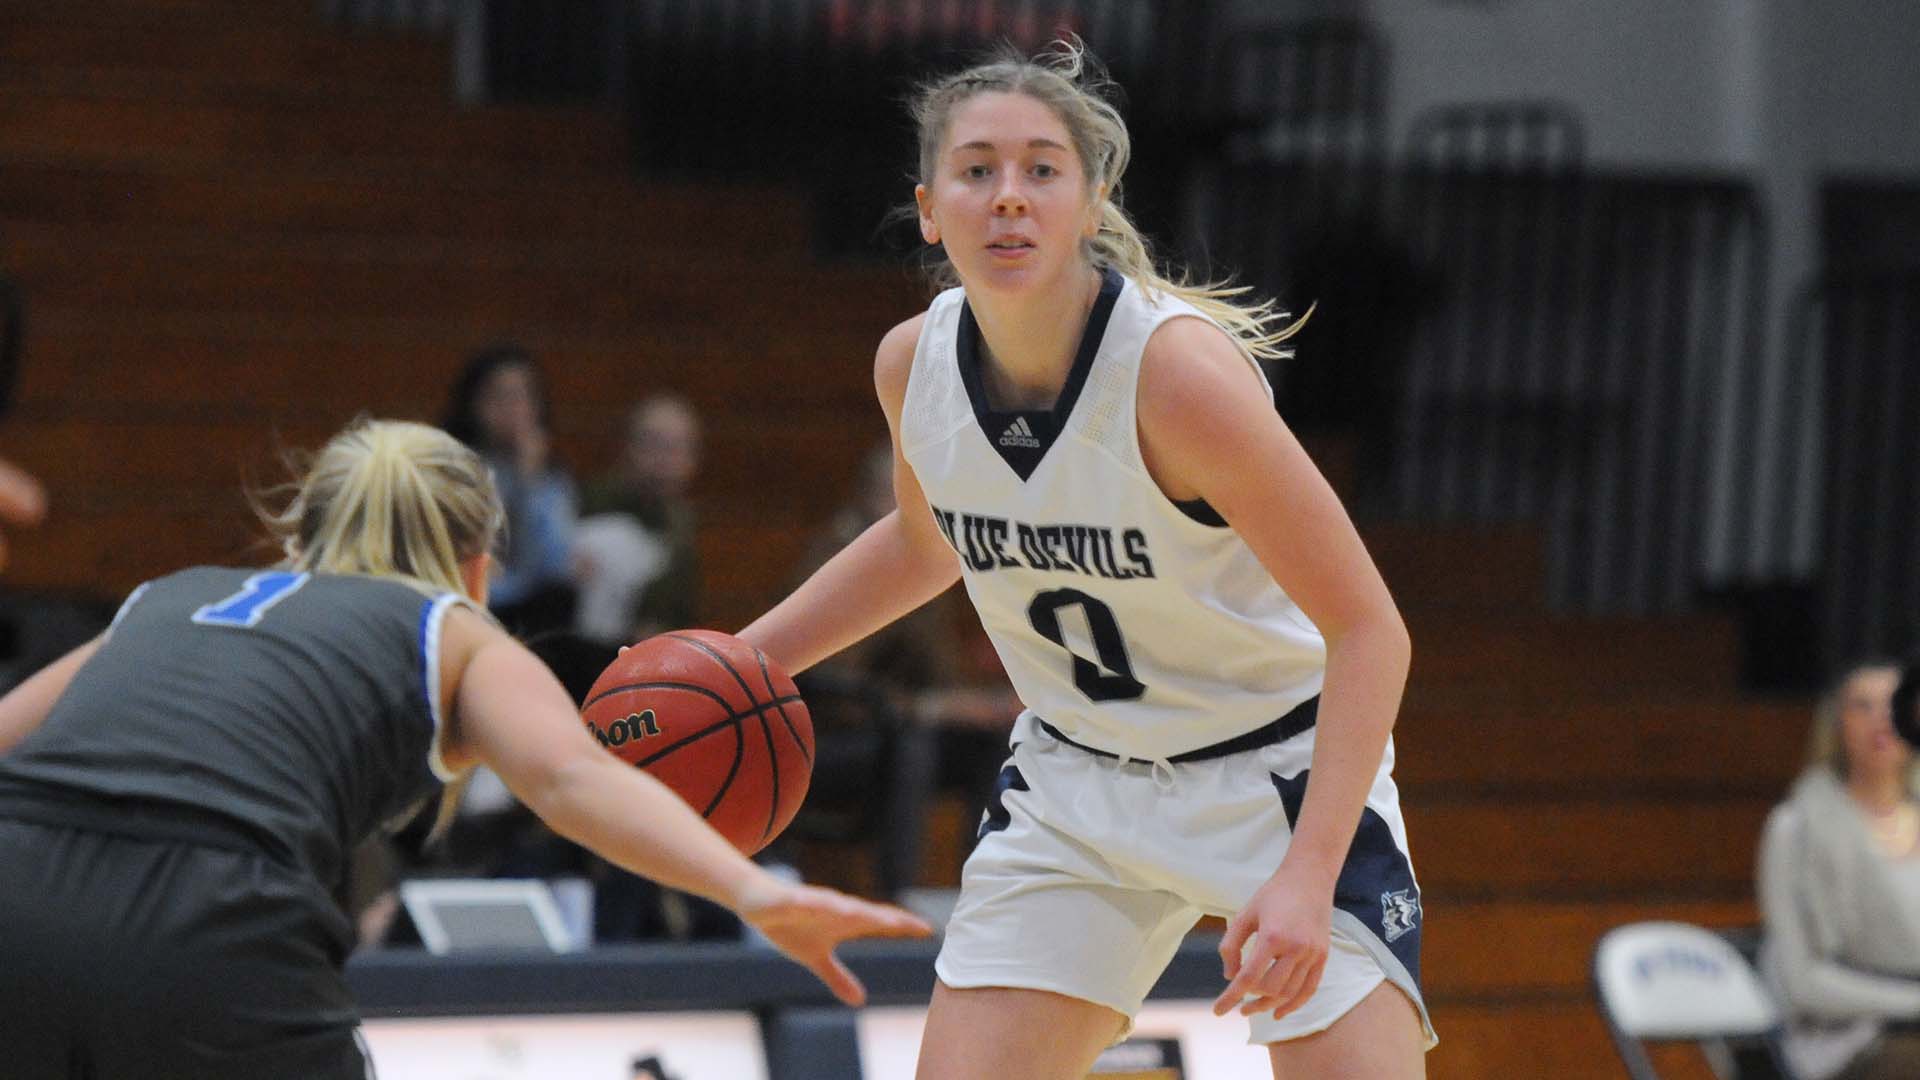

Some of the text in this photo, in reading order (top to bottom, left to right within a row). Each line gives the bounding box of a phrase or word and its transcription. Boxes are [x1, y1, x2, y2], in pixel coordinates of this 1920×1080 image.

[999, 433, 1040, 448] adidas
[1016, 521, 1155, 579] DEVILS
[190, 571, 311, 628] 1
[1024, 586, 1148, 704] 0
